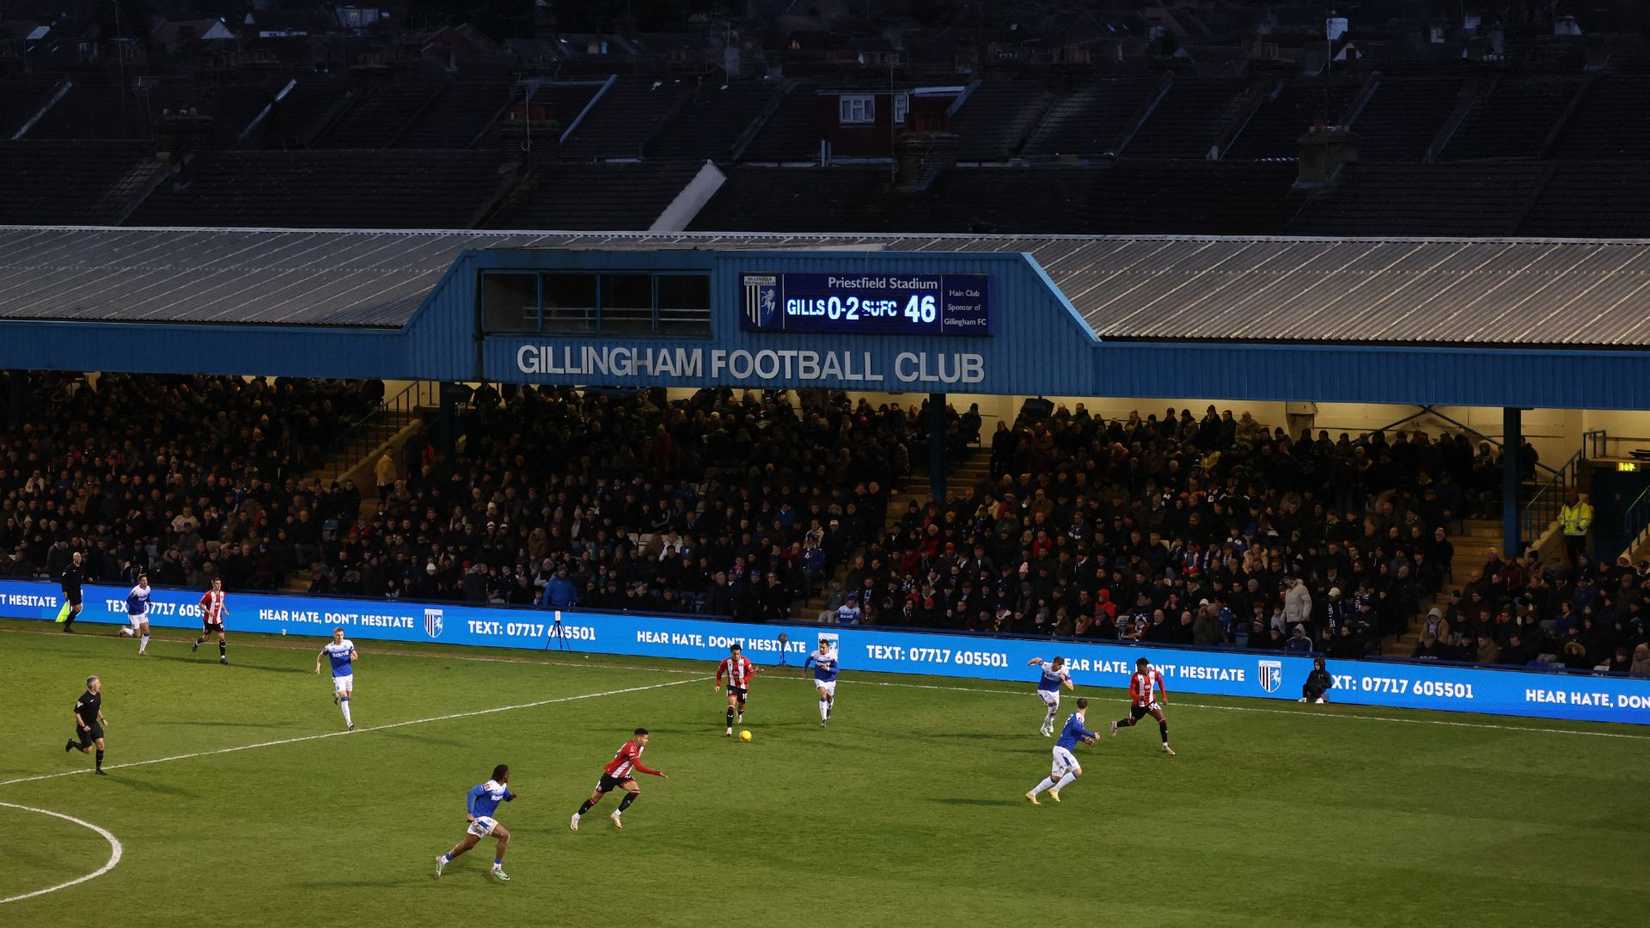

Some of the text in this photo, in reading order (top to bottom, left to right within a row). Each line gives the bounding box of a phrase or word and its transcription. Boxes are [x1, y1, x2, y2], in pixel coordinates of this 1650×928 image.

[828, 276, 938, 290] Priestfield Stadium
[787, 299, 825, 316] GILLS
[827, 296, 859, 320] 0-2
[904, 295, 936, 323] 46
[943, 318, 987, 327] Gillingham FC
[516, 344, 986, 384] GILLINGHAM FOOTBALL CLUB
[9, 594, 57, 608] HESITATE
[106, 599, 129, 613] TEX
[259, 609, 414, 628] HEAR HATE, DON'T HESITATE
[467, 620, 503, 635] TEXT:
[506, 622, 545, 638] 07717
[637, 630, 807, 653] HEAR HATE, DON'T HESITATE
[866, 644, 1009, 667] TEXT: 07717 605501
[1063, 657, 1090, 671] EAR
[1093, 660, 1131, 676] HATE,
[1180, 665, 1245, 682] HESITATE
[1331, 674, 1473, 699] XT: 07717 605501
[1525, 688, 1567, 705] HEAR
[1570, 691, 1614, 708] HATE,
